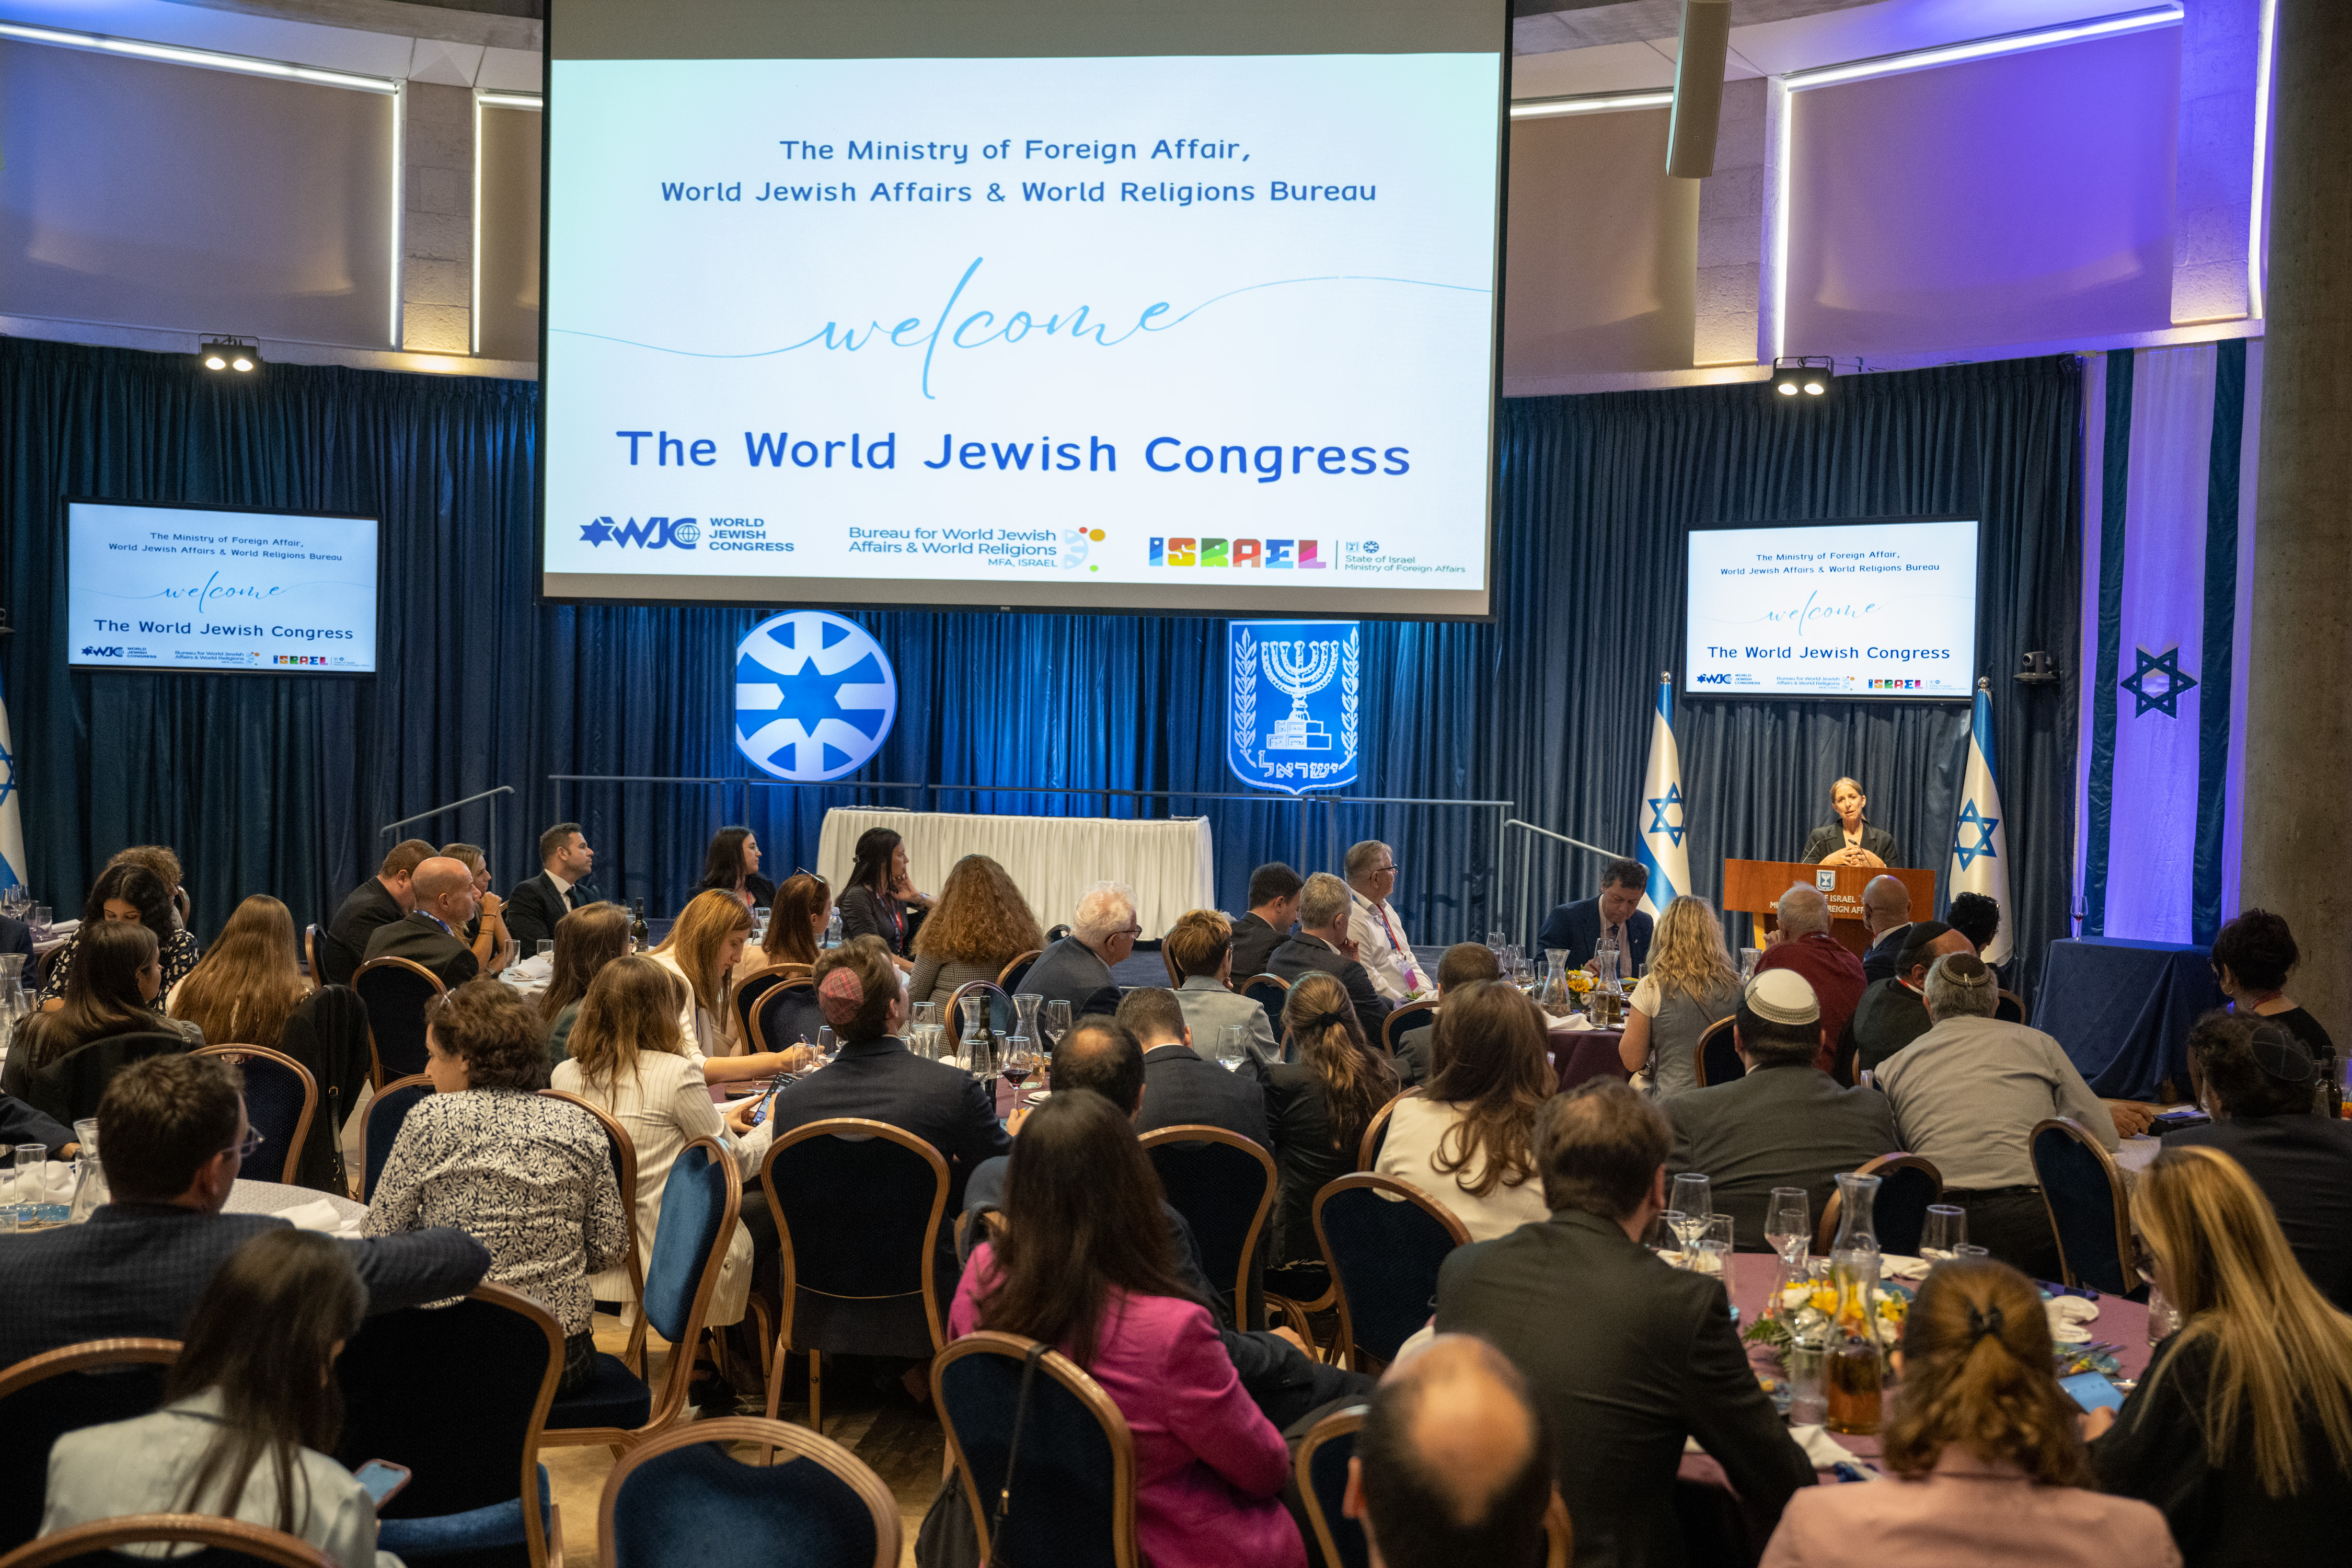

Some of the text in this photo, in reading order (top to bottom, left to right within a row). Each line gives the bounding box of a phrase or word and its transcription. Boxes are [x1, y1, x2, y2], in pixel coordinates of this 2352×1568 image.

[778, 138, 1251, 166] The Ministry of Foreign Affair,
[660, 180, 1377, 207] World Jewish Affairs & World Religions Bureau
[814, 256, 1182, 400] welcome
[615, 430, 1410, 485] The World Jewish Congress
[709, 517, 765, 528] WORLD
[173, 533, 214, 544] Ministry
[232, 536, 268, 546] Foreign
[272, 539, 304, 548] Affair,
[612, 516, 698, 550] WJC
[708, 529, 767, 540] JEWISH
[849, 527, 1056, 541] Bureau for World Jewish
[108, 543, 137, 551] World
[142, 545, 177, 553] Jewish
[180, 546, 215, 555] Affairs
[231, 549, 258, 557] World
[263, 550, 306, 560] Religions
[708, 541, 795, 552] CONGRESS
[848, 541, 1057, 558] Affairs & World Religions
[1149, 537, 1327, 569] ISRAEL
[988, 558, 1058, 567] MFA, ISRAEL
[1345, 555, 1415, 564] State of Israel
[1345, 563, 1382, 572] Ministry
[1396, 564, 1433, 573] Foreign
[1860, 565, 1901, 573] Religions
[161, 571, 285, 614] welcome
[1767, 590, 1882, 636] welcome
[93, 619, 353, 641] The World Jewish Congress
[1707, 646, 1950, 662] The World Jewish Congress
[1258, 750, 1339, 779] ישראל
[1830, 894, 1856, 904] ISRAEL
[1828, 905, 1850, 914] REIGN
